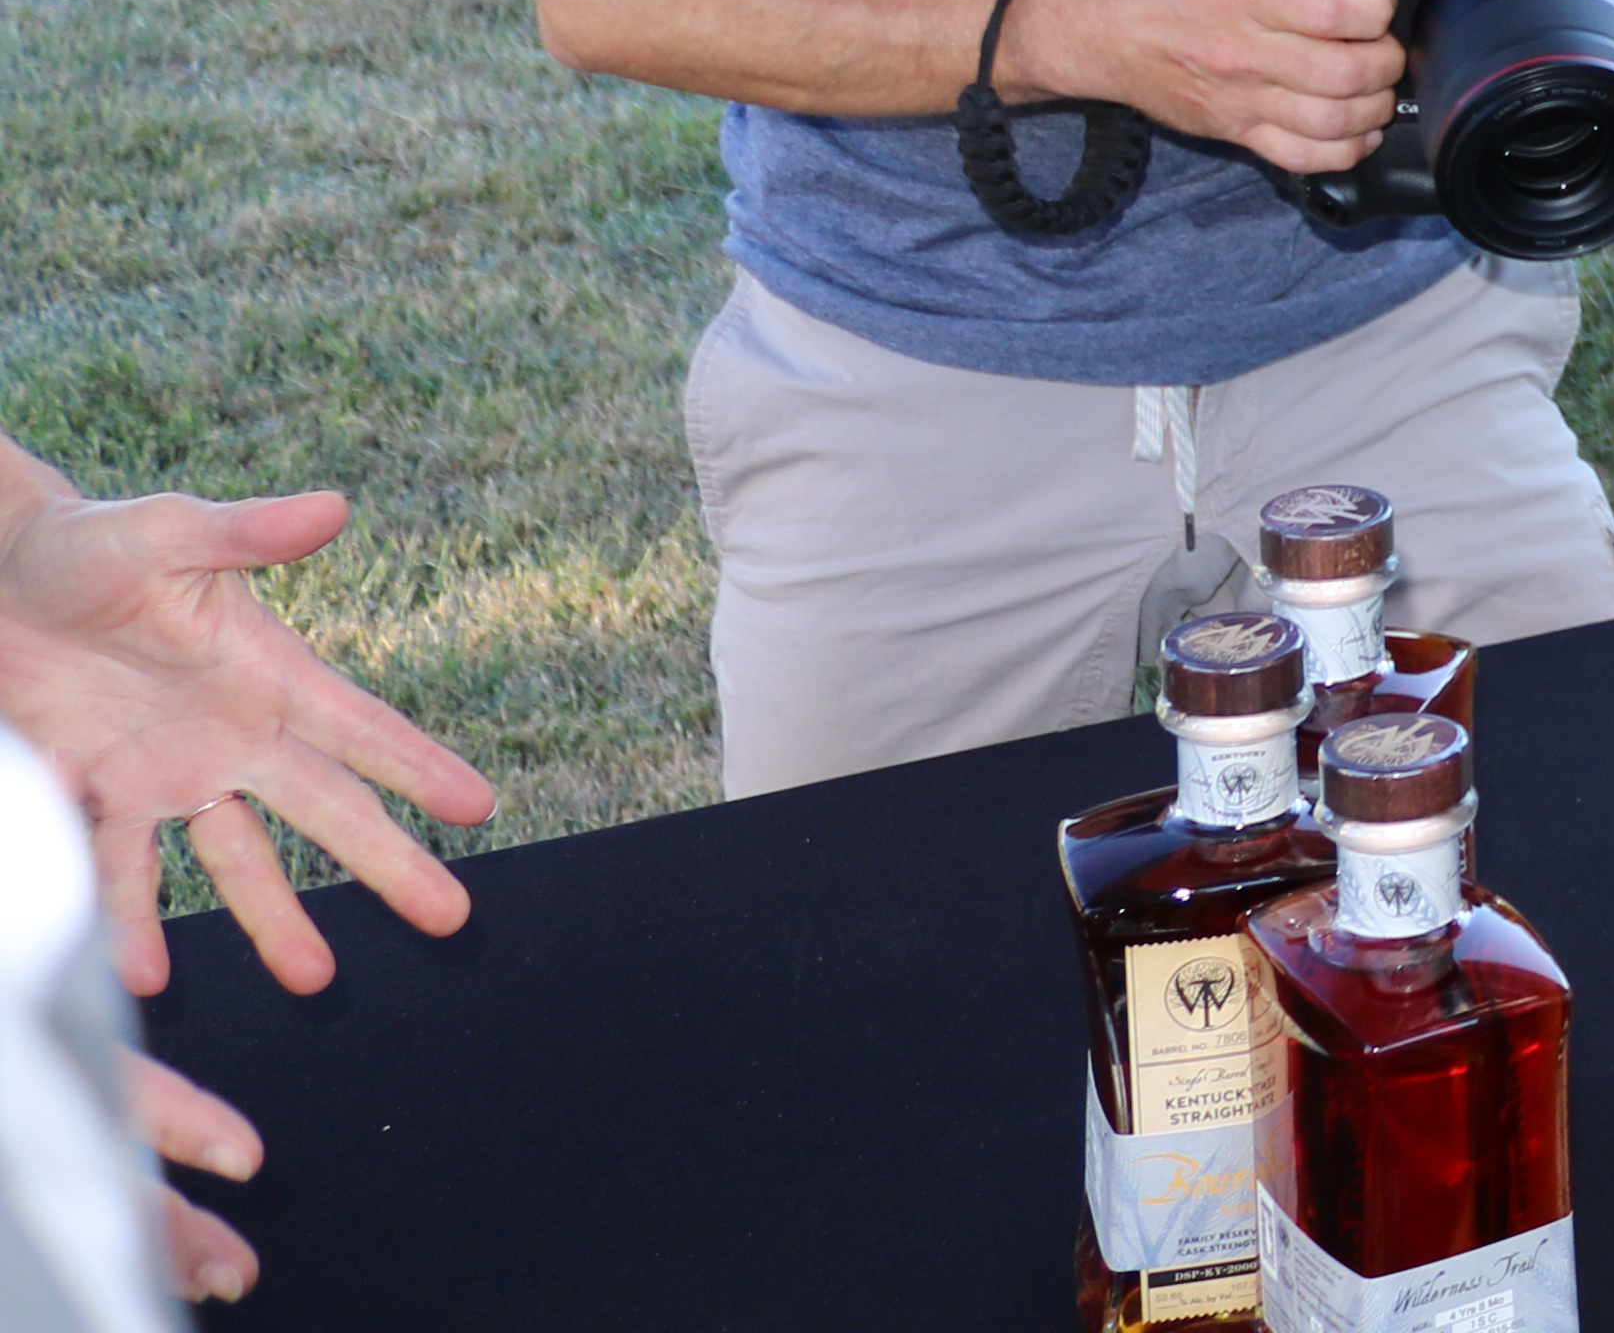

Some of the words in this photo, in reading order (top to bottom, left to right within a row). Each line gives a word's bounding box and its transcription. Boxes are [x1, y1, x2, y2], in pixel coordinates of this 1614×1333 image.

[1170, 1101, 1252, 1126] STRAIGHT
[1219, 1227, 1258, 1241] RESERV
[1210, 1238, 1257, 1253] STRENGT
[1393, 1270, 1485, 1314] Wilderness
[1487, 1238, 1548, 1287] Trail
